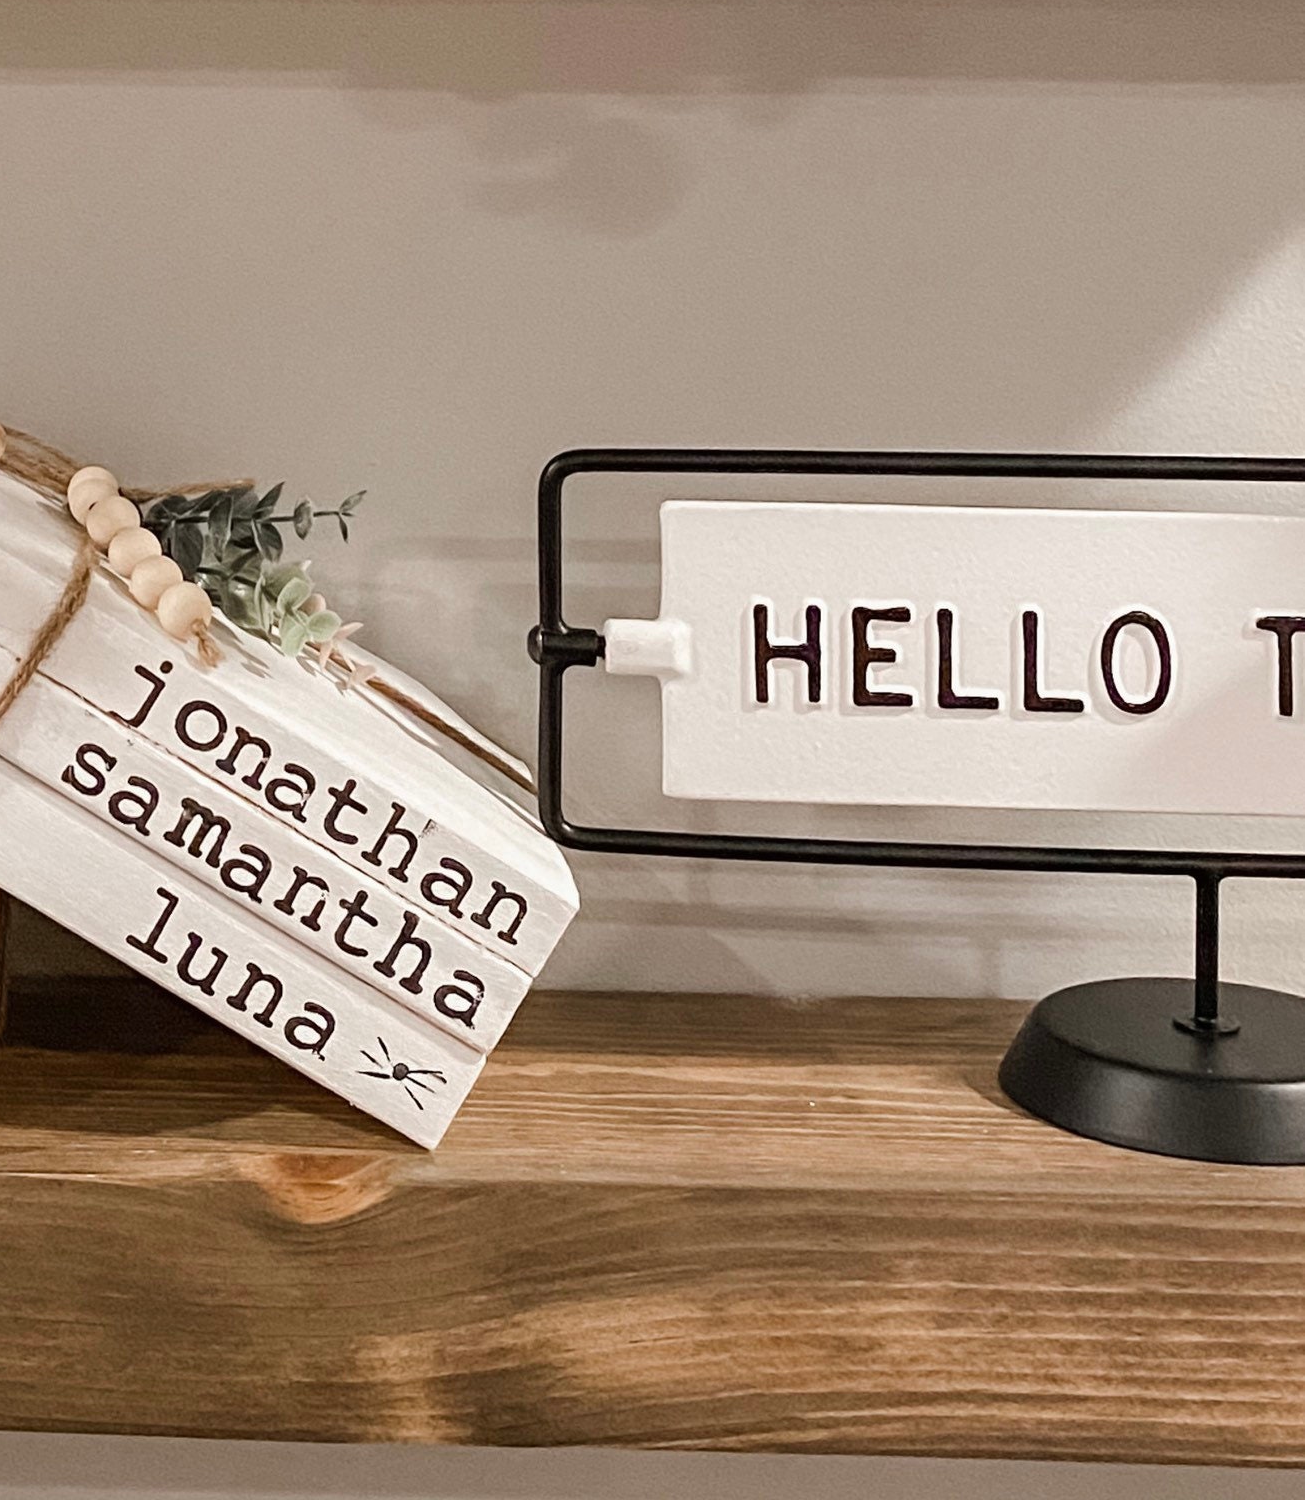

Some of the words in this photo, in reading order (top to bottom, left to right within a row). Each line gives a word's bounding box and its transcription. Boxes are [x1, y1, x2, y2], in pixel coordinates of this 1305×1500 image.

[753, 603, 1172, 715] HELLO
[61, 743, 488, 1030] samantha
[108, 660, 529, 945] jonathan
[126, 887, 336, 1061] luna
